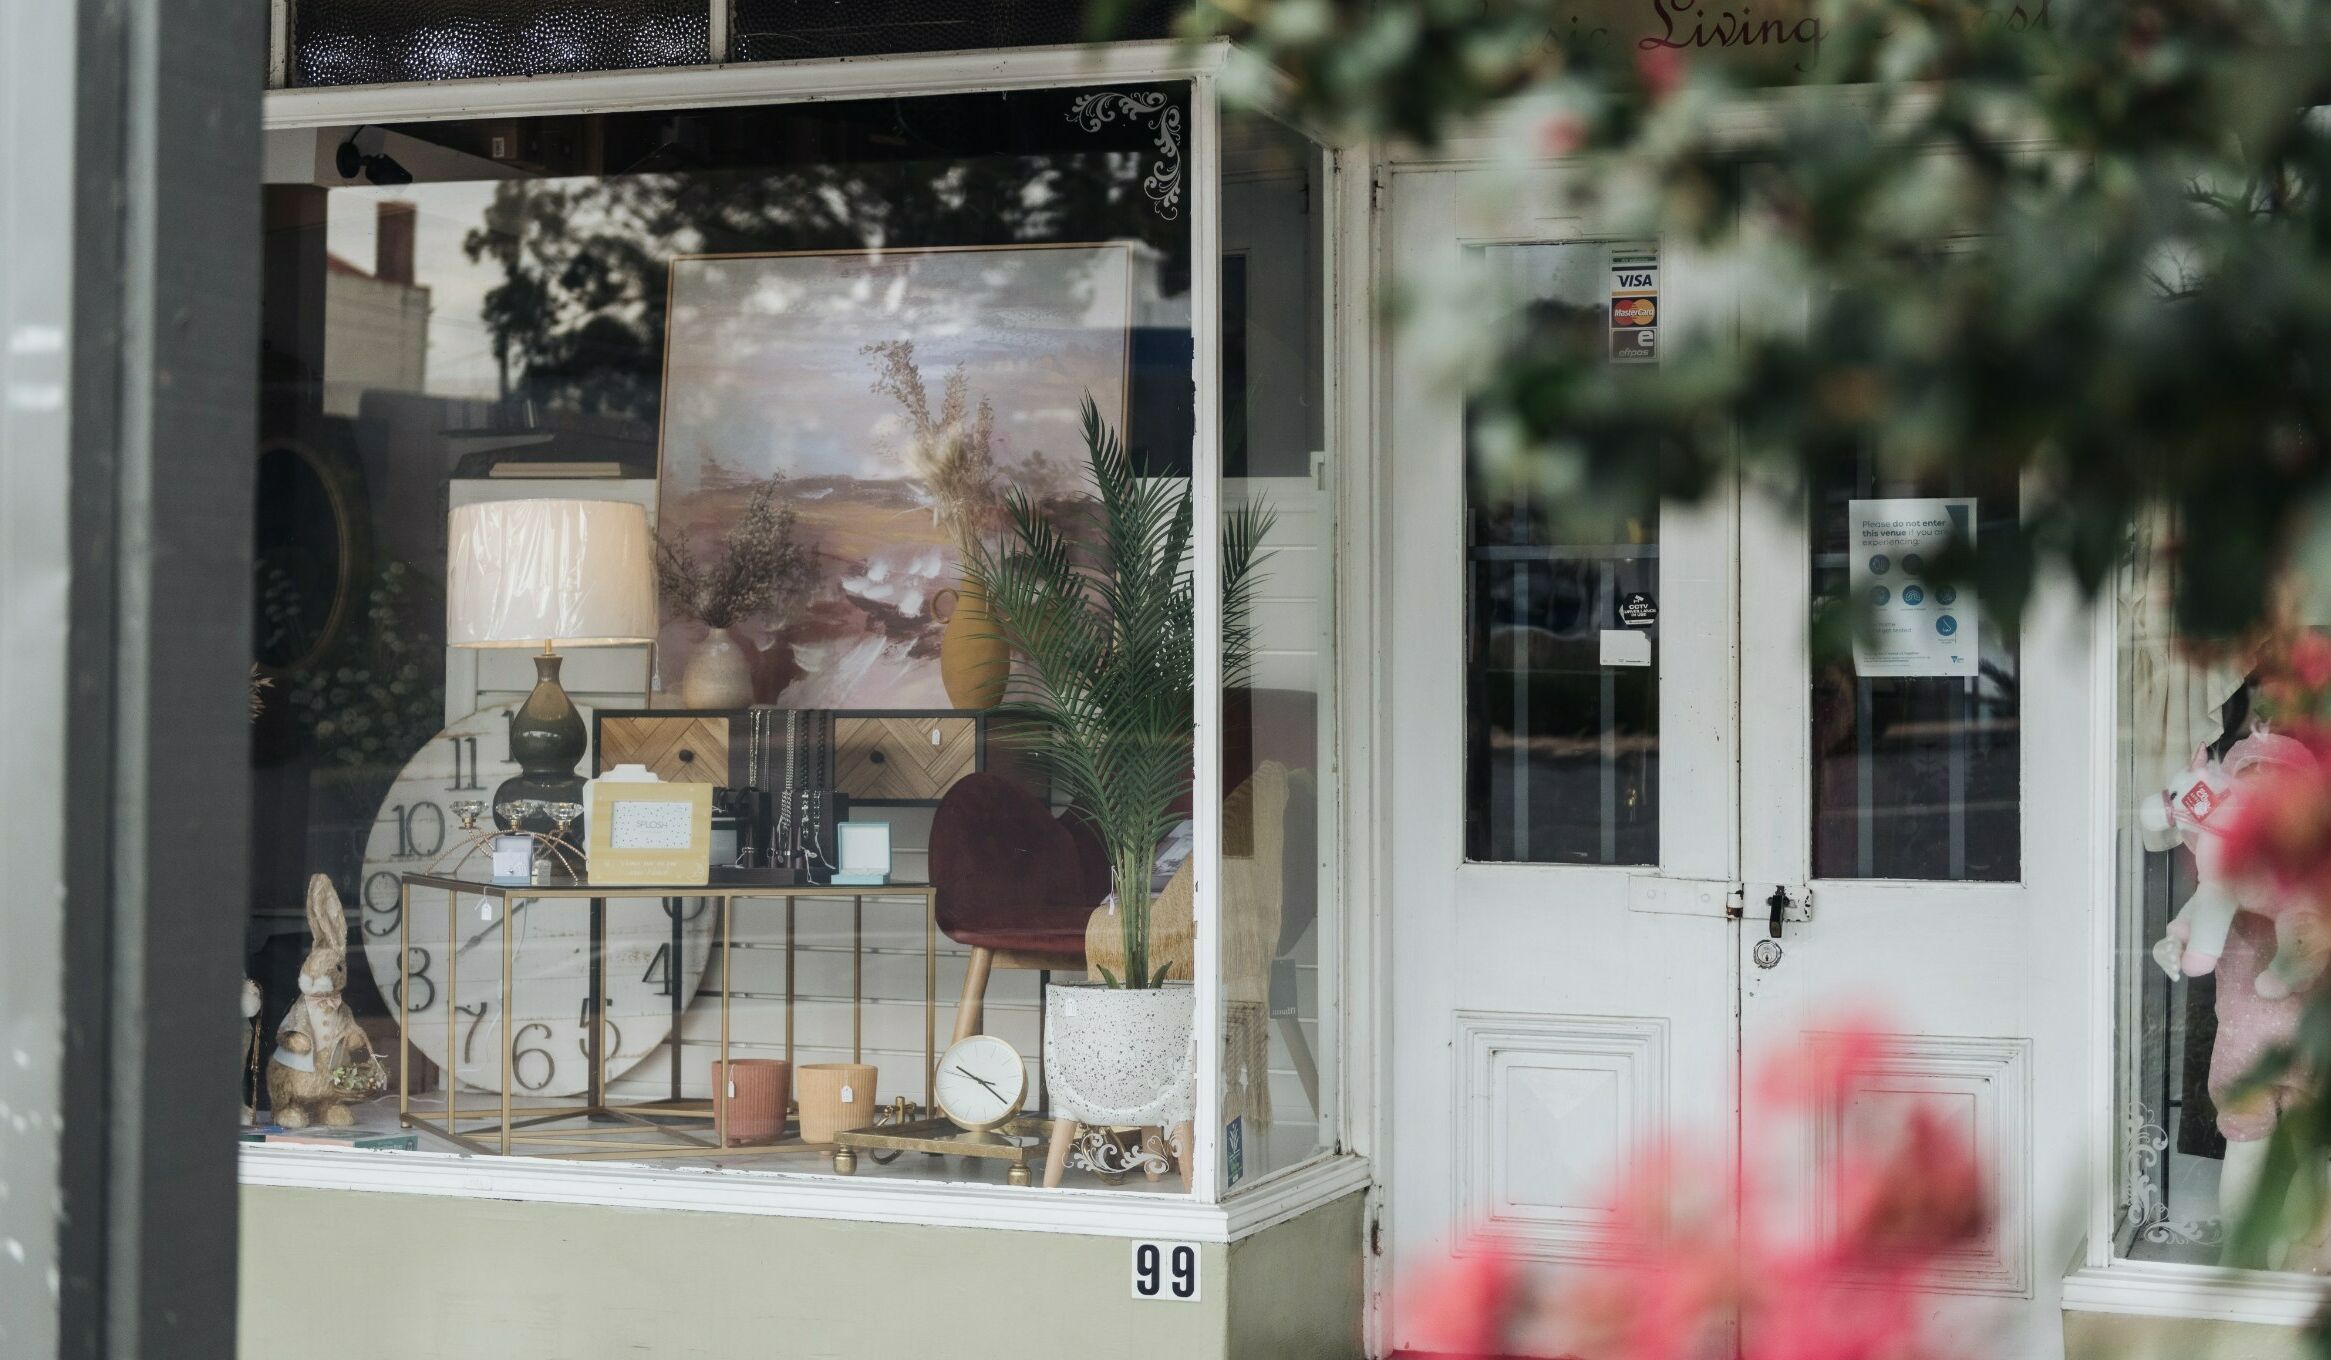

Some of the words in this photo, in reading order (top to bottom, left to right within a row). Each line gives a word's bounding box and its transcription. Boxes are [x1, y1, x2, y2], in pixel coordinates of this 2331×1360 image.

[1638, 0, 1829, 73] Living
[1617, 274, 1653, 288] VISA
[1614, 306, 1656, 318] MasterCard
[1862, 520, 1891, 528] Please
[1892, 520, 1904, 528] do
[1905, 520, 1921, 528] not
[1922, 519, 1946, 527] enter
[1862, 530, 1879, 538] this
[444, 736, 488, 791] 11
[391, 801, 446, 858] 10
[364, 871, 402, 937] 9
[393, 947, 435, 1012] 8
[642, 942, 674, 996] 4
[447, 1002, 488, 1064] 7
[512, 1023, 555, 1090] 6
[579, 998, 621, 1062] 5
[1136, 1244, 1195, 1298] 99
